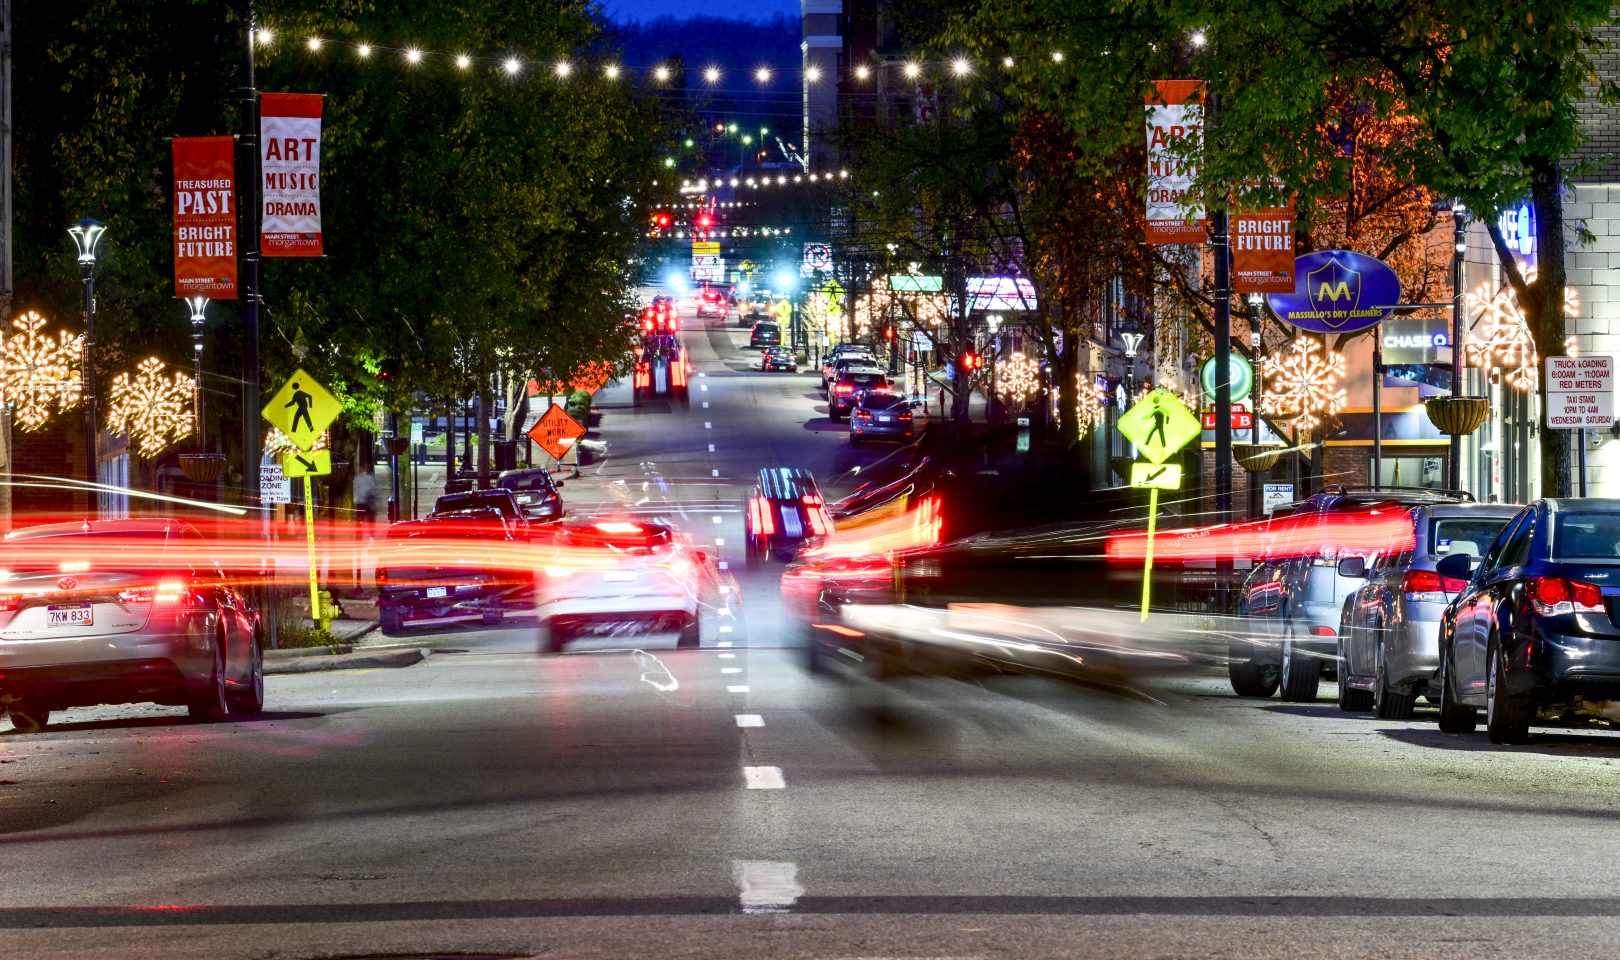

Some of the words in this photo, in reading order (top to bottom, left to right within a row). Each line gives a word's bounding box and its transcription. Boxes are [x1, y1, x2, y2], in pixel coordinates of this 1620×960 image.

[265, 137, 317, 161] ART
[177, 179, 231, 189] TREASURED
[265, 172, 317, 190] MUSIC
[177, 191, 232, 215] PAST
[265, 202, 318, 216] DRAMA
[1153, 226, 1204, 235] morgantown
[1238, 220, 1291, 234] BRIGHT
[178, 226, 233, 241] BRIGHT
[268, 239, 320, 249] morgantown
[1237, 235, 1292, 251] FUTURE
[178, 241, 233, 258] FUTURE
[1241, 276, 1293, 285] morgantown
[183, 282, 235, 292] morgantown
[1288, 310, 1331, 319] MASSULLO'S
[1332, 309, 1348, 318] DRY
[1349, 308, 1383, 318] CLEANERS
[1384, 335, 1432, 348] CHASE
[1554, 360, 1576, 369] TRUCK
[1578, 359, 1608, 369] LOADING
[1551, 370, 1576, 379] 6:00AM
[1584, 369, 1610, 379] 11:00AM
[1559, 380, 1573, 389] RED
[1575, 380, 1602, 389] METERS
[1566, 395, 1578, 404] TAXI
[1578, 395, 1596, 404] STAND
[1563, 406, 1577, 414] 10PM
[1579, 405, 1586, 414] TO
[1587, 405, 1599, 414] 4AM
[543, 418, 568, 427] UTILITY
[1240, 416, 1251, 426] B
[1551, 416, 1583, 425] WEDNESDAY
[1586, 415, 1612, 425] SATURDAY
[547, 429, 566, 437] WORK
[49, 612, 68, 622] 7KW
[71, 610, 90, 620] 833
